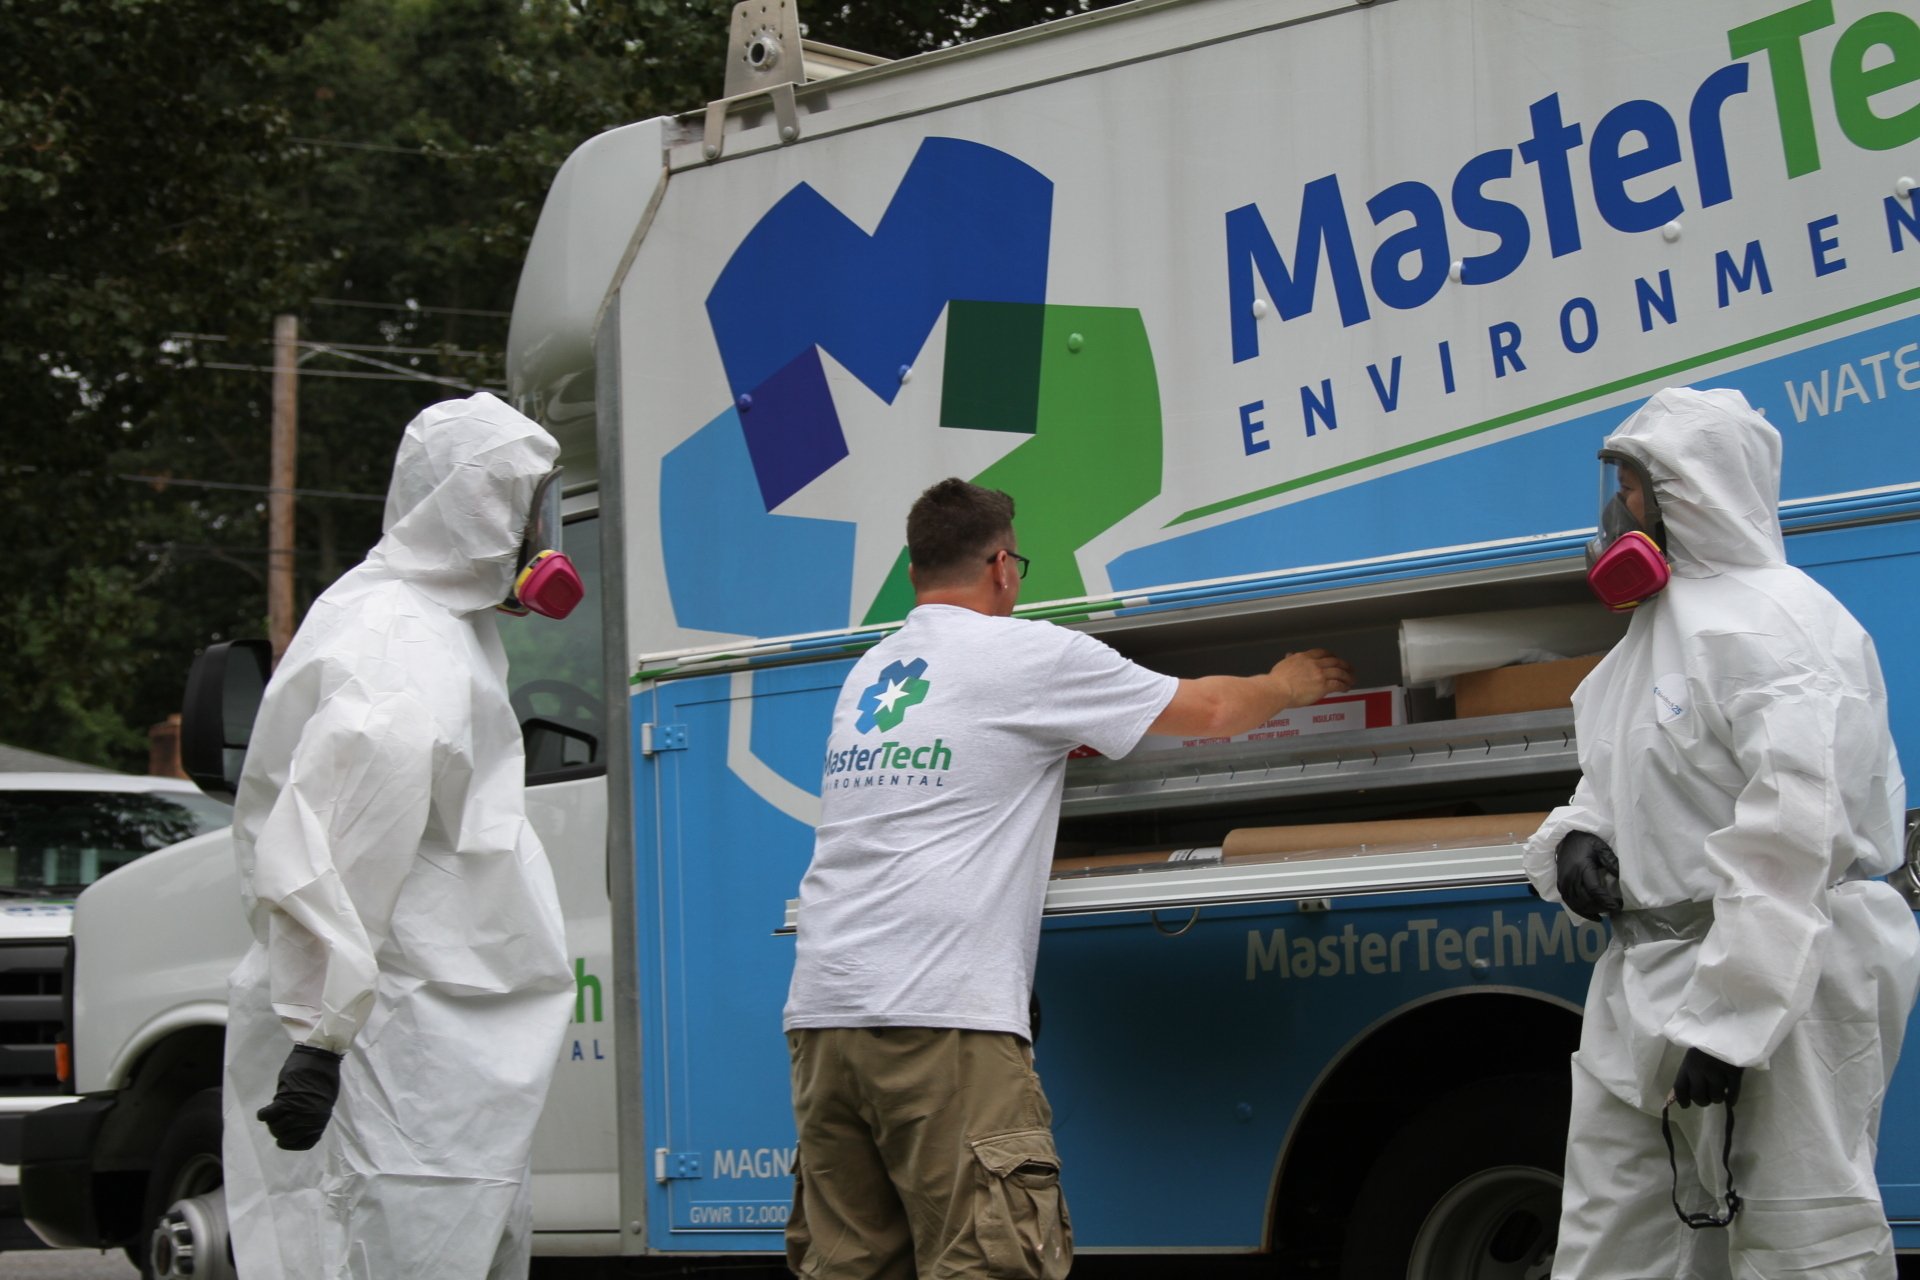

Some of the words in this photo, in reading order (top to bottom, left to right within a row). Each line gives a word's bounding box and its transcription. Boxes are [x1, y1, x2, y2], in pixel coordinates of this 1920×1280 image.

[1238, 186, 1920, 456] ENVIRONMEN
[1784, 342, 1920, 424] WATE
[1312, 712, 1345, 724] INSULATION
[690, 1206, 732, 1223] GVWR
[737, 1206, 788, 1224] 12,000
